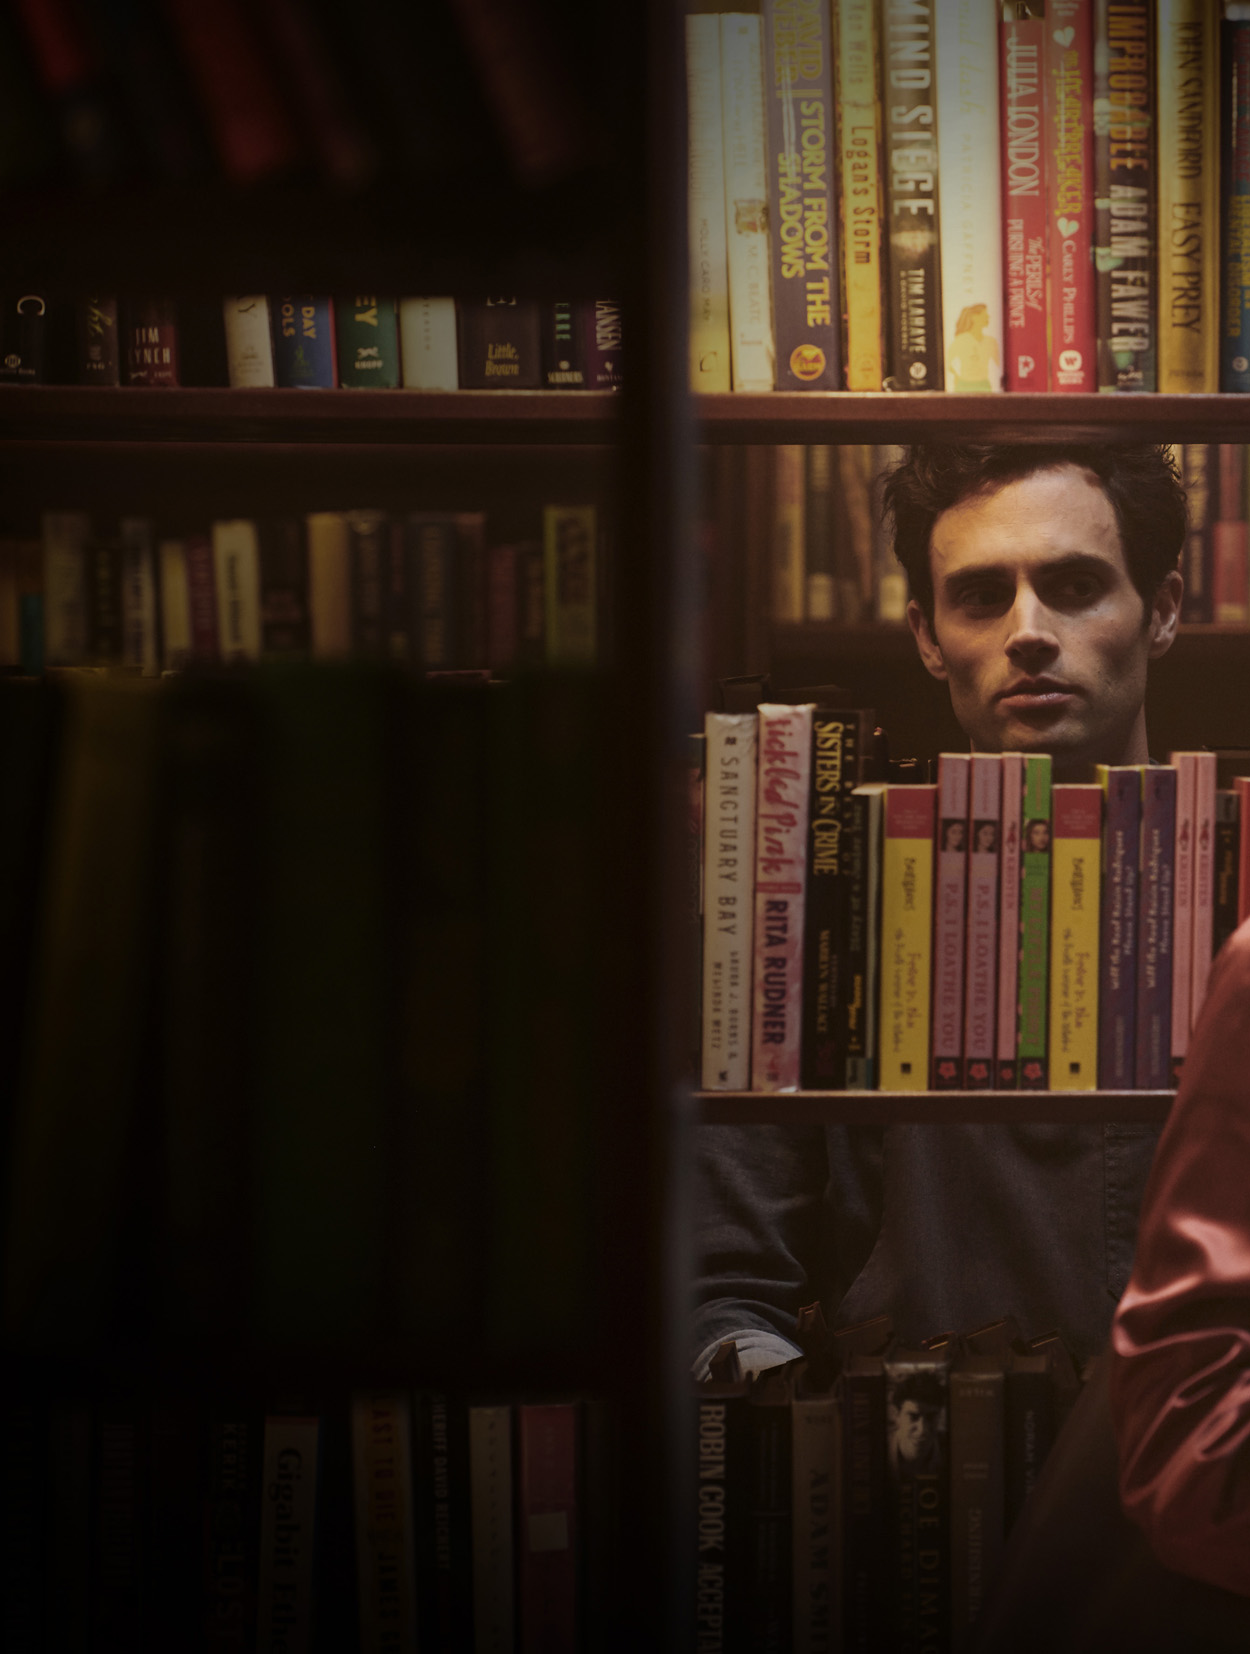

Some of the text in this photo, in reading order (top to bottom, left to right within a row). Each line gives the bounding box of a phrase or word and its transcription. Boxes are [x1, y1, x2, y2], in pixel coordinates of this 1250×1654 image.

[889, 0, 935, 217] MIND SIEGE
[1006, 37, 1041, 197] JULIA LONDON
[1108, 5, 1149, 171] IMPROBABLE
[845, 125, 876, 197] Logan's
[1051, 69, 1084, 217] HEARTBREAKER
[1170, 21, 1204, 337] JOHN SANDFORD EASY PREY
[777, 151, 804, 280] SHADOWS
[800, 101, 831, 329] STORM FROM THE
[854, 206, 878, 266] Storm
[1006, 218, 1025, 276] PURSUING
[1107, 184, 1150, 257] ADAM
[960, 218, 976, 295] GAFFNEY
[1025, 254, 1044, 297] PERILS
[301, 306, 319, 340] DAY
[907, 268, 927, 354] TIM LAHAYE
[1007, 288, 1026, 329] PRINCE
[1108, 270, 1151, 354] FAWER
[1227, 262, 1242, 338] DISORDER
[136, 326, 160, 347] JIM
[488, 342, 520, 363] Little,
[485, 360, 520, 378] Brown
[811, 720, 846, 877] SISTERS IN CRIME
[718, 756, 739, 937] SANCTUARY BAY
[759, 813, 798, 877] Pink
[764, 900, 790, 948] RITA
[945, 883, 961, 915] P.S.
[975, 884, 991, 916] P.S.
[1027, 887, 1044, 914] MY
[1025, 918, 1044, 980] LITTLE
[1110, 919, 1122, 946] Real
[1110, 947, 1121, 965] the
[943, 931, 960, 1005] LOATHE
[973, 932, 990, 1006] LOATHE
[1109, 967, 1121, 990] Will
[762, 956, 788, 1046] RUDNER
[942, 1013, 957, 1051] YOU
[972, 1014, 988, 1052] YOU
[711, 1018, 722, 1050] METZ
[431, 1393, 448, 1453] SHERIFF
[1023, 1409, 1037, 1464] NORAH
[221, 1422, 239, 1491] KERIK
[373, 1456, 396, 1482] TO
[432, 1455, 449, 1499] DAVID
[267, 1447, 303, 1570] Gigabit
[373, 1489, 397, 1524] DIE
[696, 1403, 728, 1654] ROBIN COOK ACCEPTA
[808, 1468, 831, 1571] ADAM
[899, 1482, 915, 1580] RICHARD
[913, 1473, 942, 1530] JOE
[214, 1552, 247, 1646] LOST
[377, 1551, 400, 1620] JAMES
